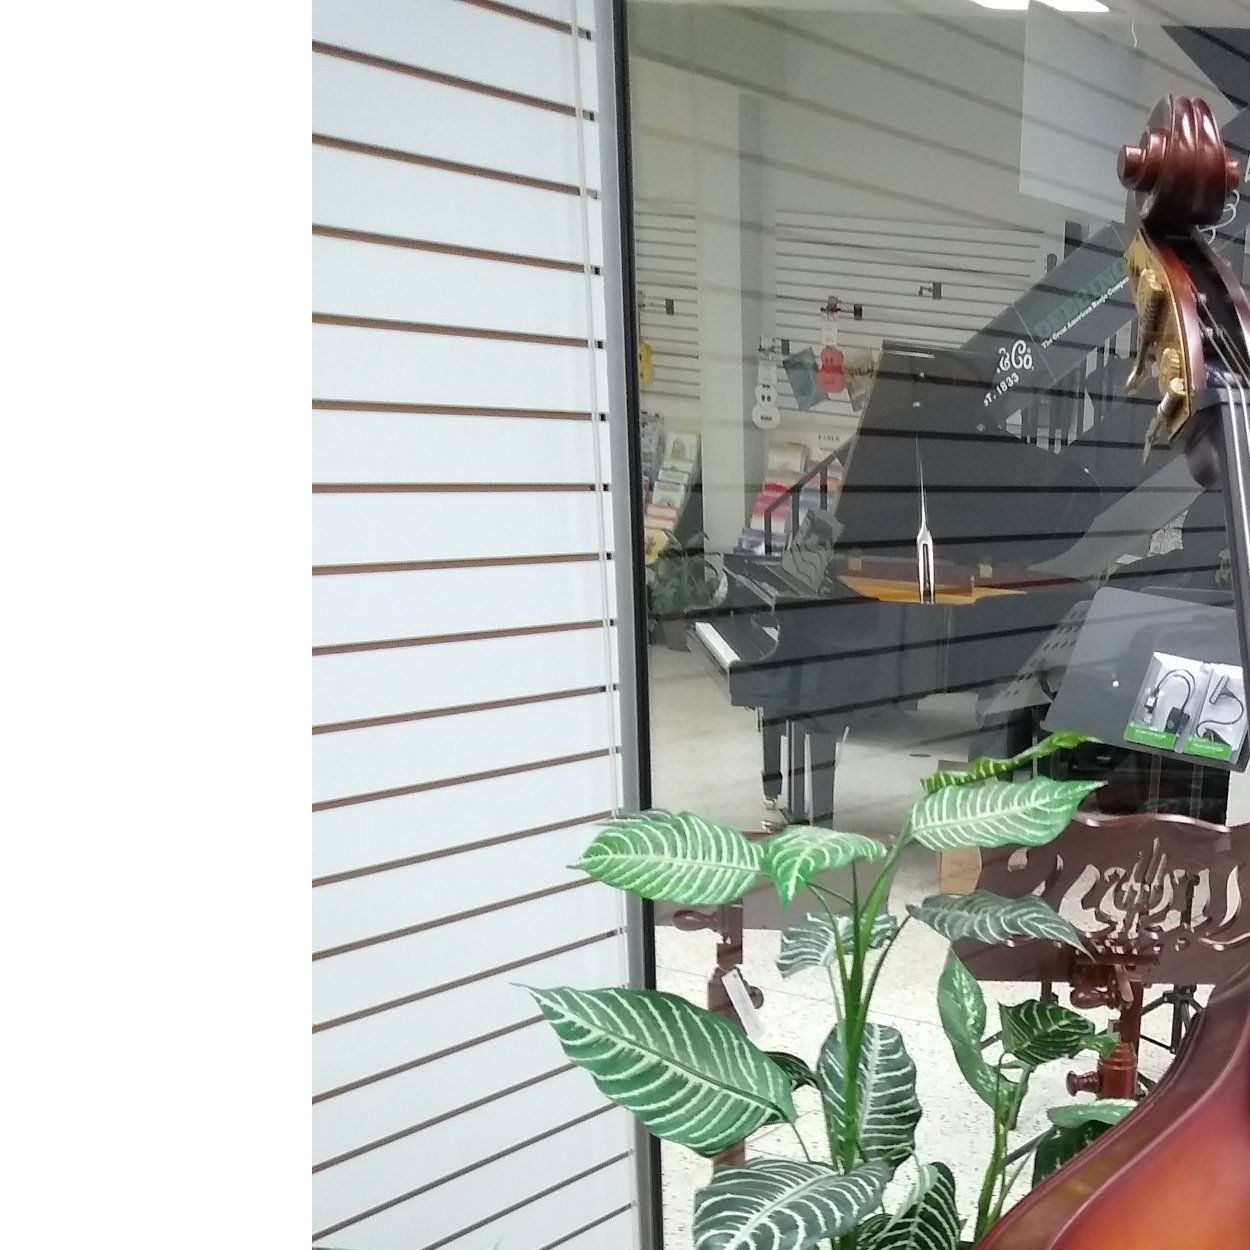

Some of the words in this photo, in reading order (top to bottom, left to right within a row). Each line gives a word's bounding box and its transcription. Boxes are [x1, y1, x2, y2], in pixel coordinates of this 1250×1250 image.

[1041, 338, 1053, 349] The
[1052, 327, 1068, 341] Great
[1066, 306, 1093, 330] American
[1091, 294, 1109, 309] Banjo
[996, 372, 1020, 396] 1833
